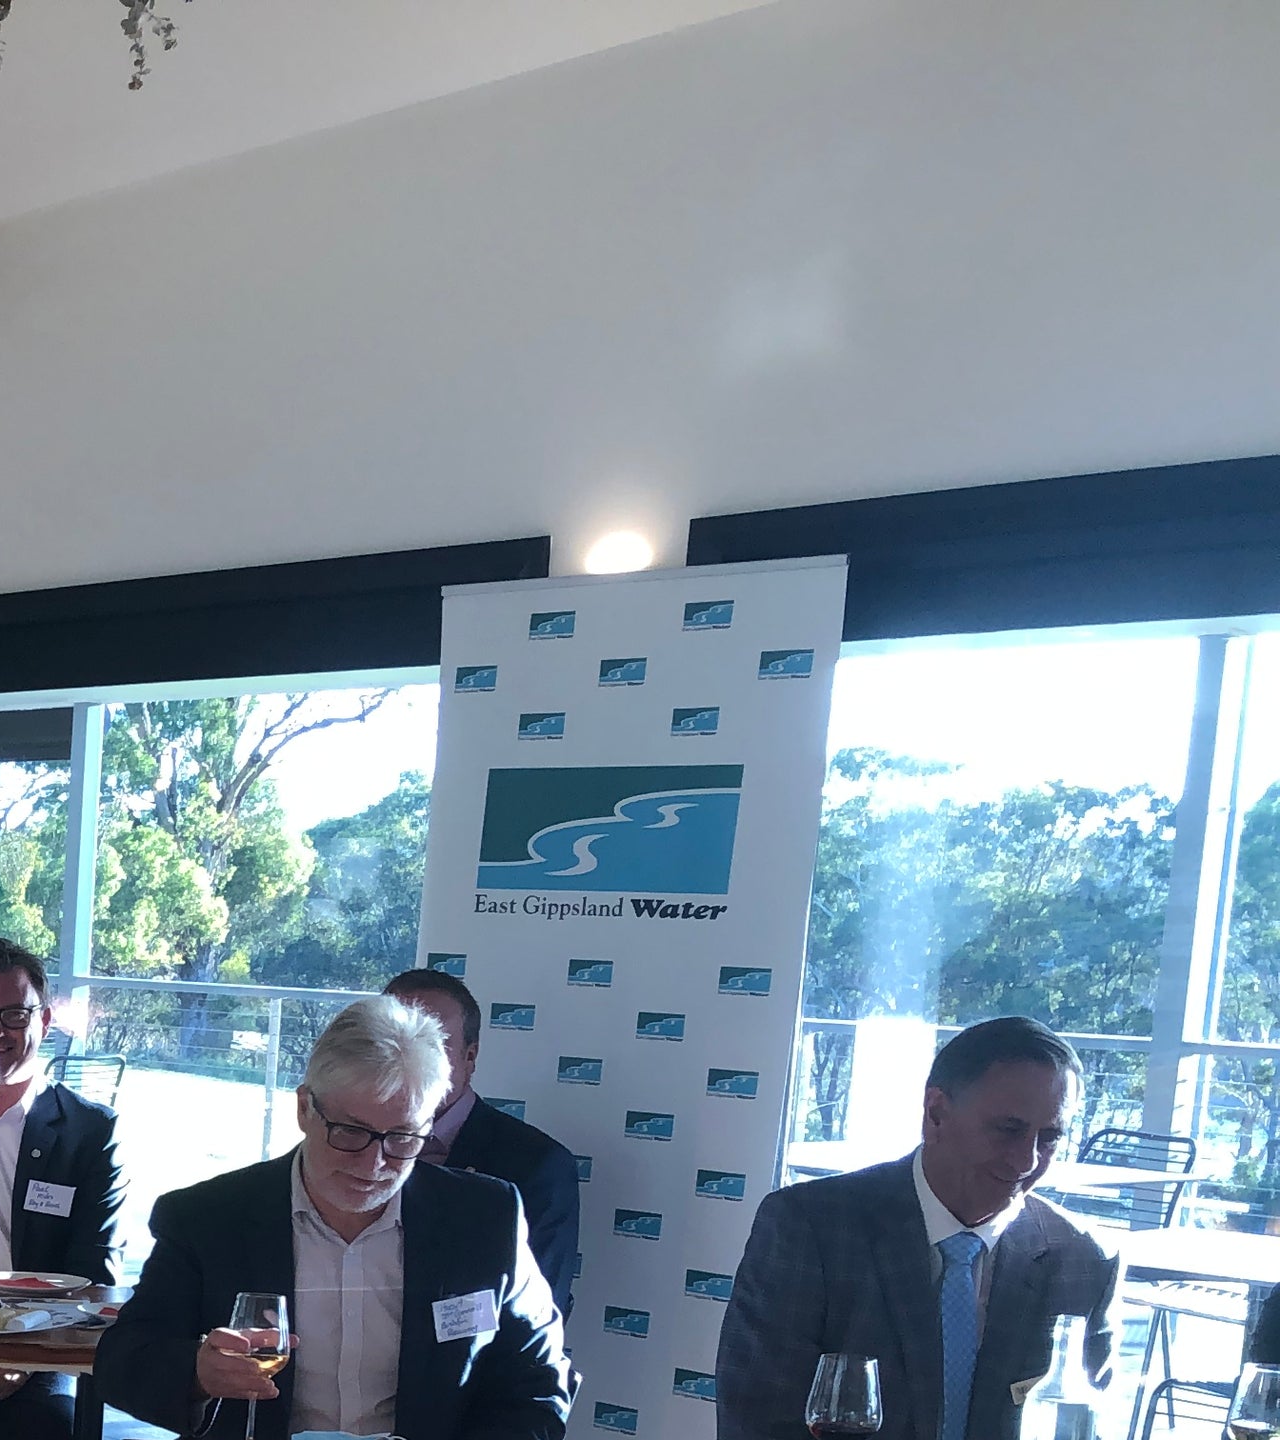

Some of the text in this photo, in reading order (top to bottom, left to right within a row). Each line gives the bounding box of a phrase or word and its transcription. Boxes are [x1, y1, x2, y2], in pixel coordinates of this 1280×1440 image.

[474, 894, 728, 921] East Gippsland Water
